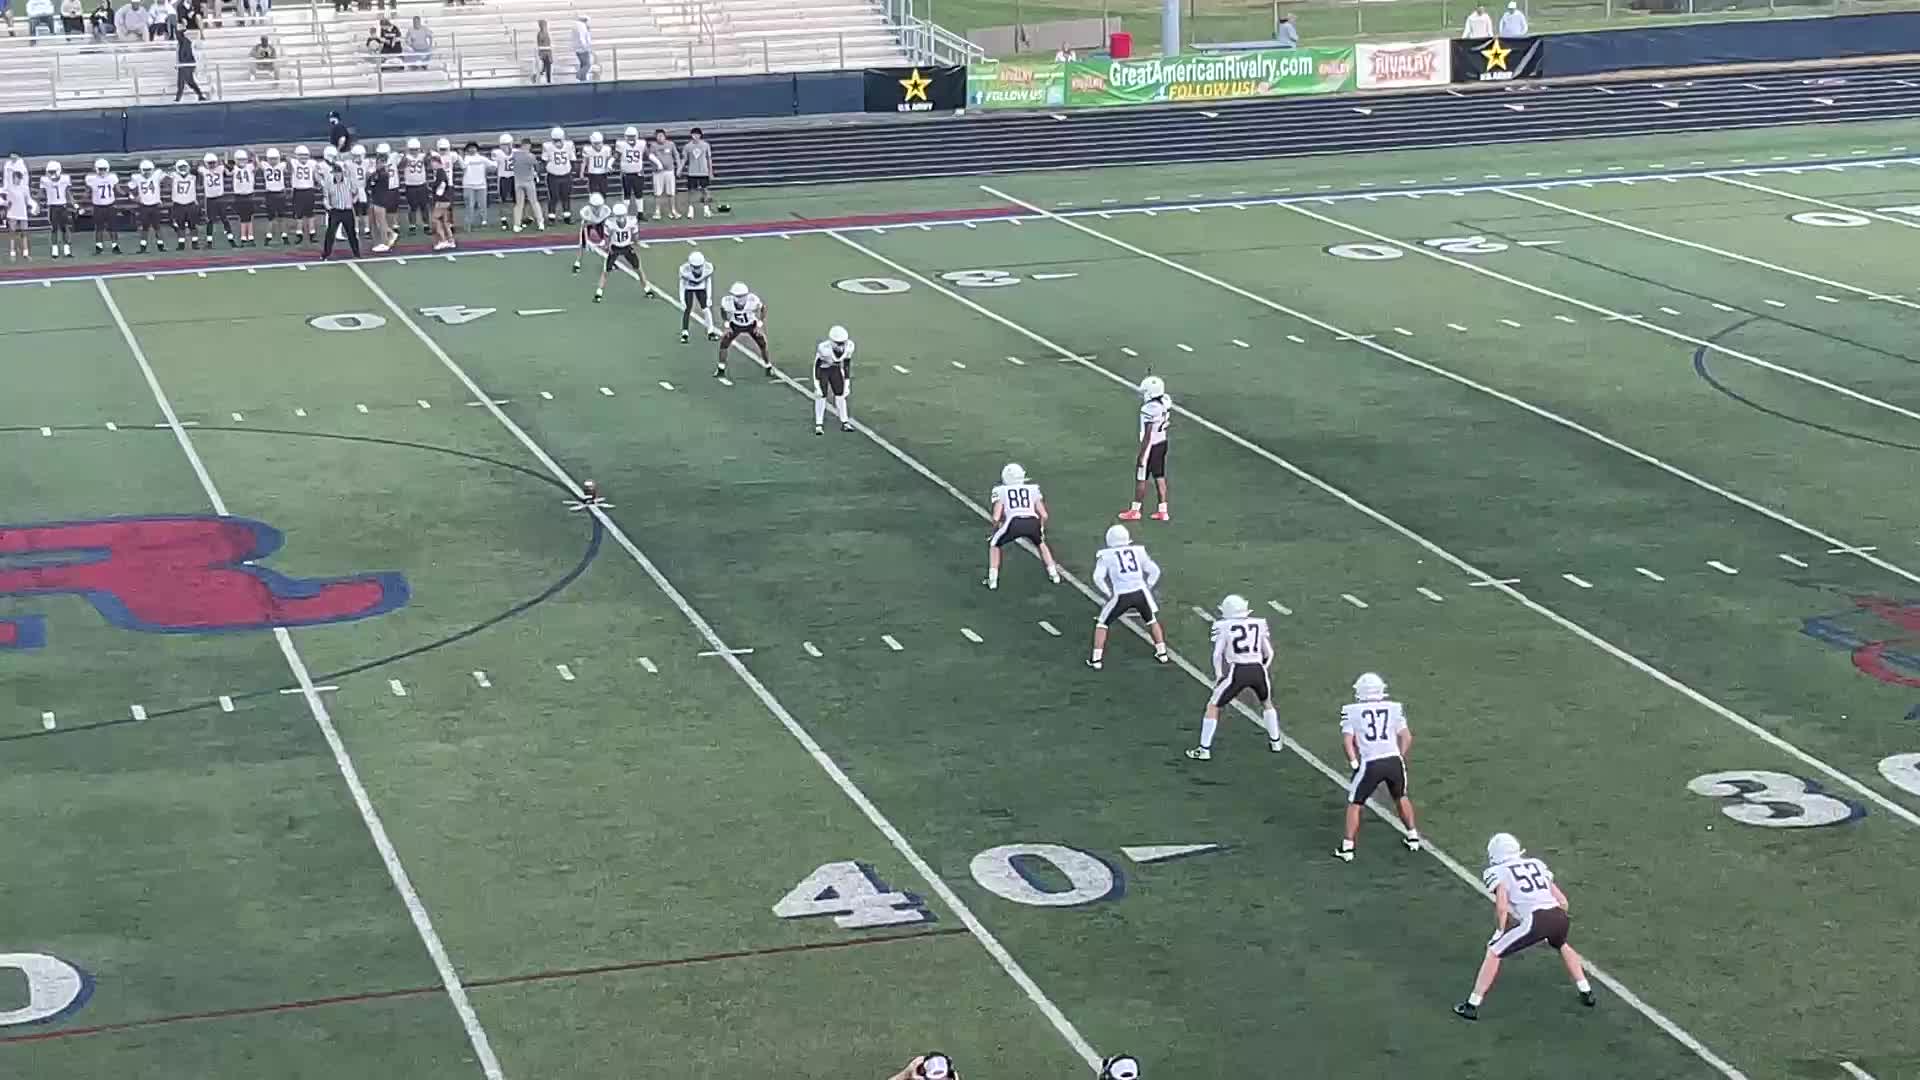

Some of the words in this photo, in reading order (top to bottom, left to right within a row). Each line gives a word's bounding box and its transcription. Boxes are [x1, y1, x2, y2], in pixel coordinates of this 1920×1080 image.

[1109, 54, 1313, 87] GreatAmericanRivalry.com
[1375, 53, 1433, 74] RIVALRY
[1168, 81, 1229, 101] FOLLOW
[98, 184, 112, 199] 71
[206, 173, 220, 187] 32
[1007, 487, 1030, 509] 88
[1115, 549, 1138, 574] 13
[1230, 624, 1260, 654] 27
[1361, 708, 1389, 742] 37
[1508, 861, 1549, 894] 52
